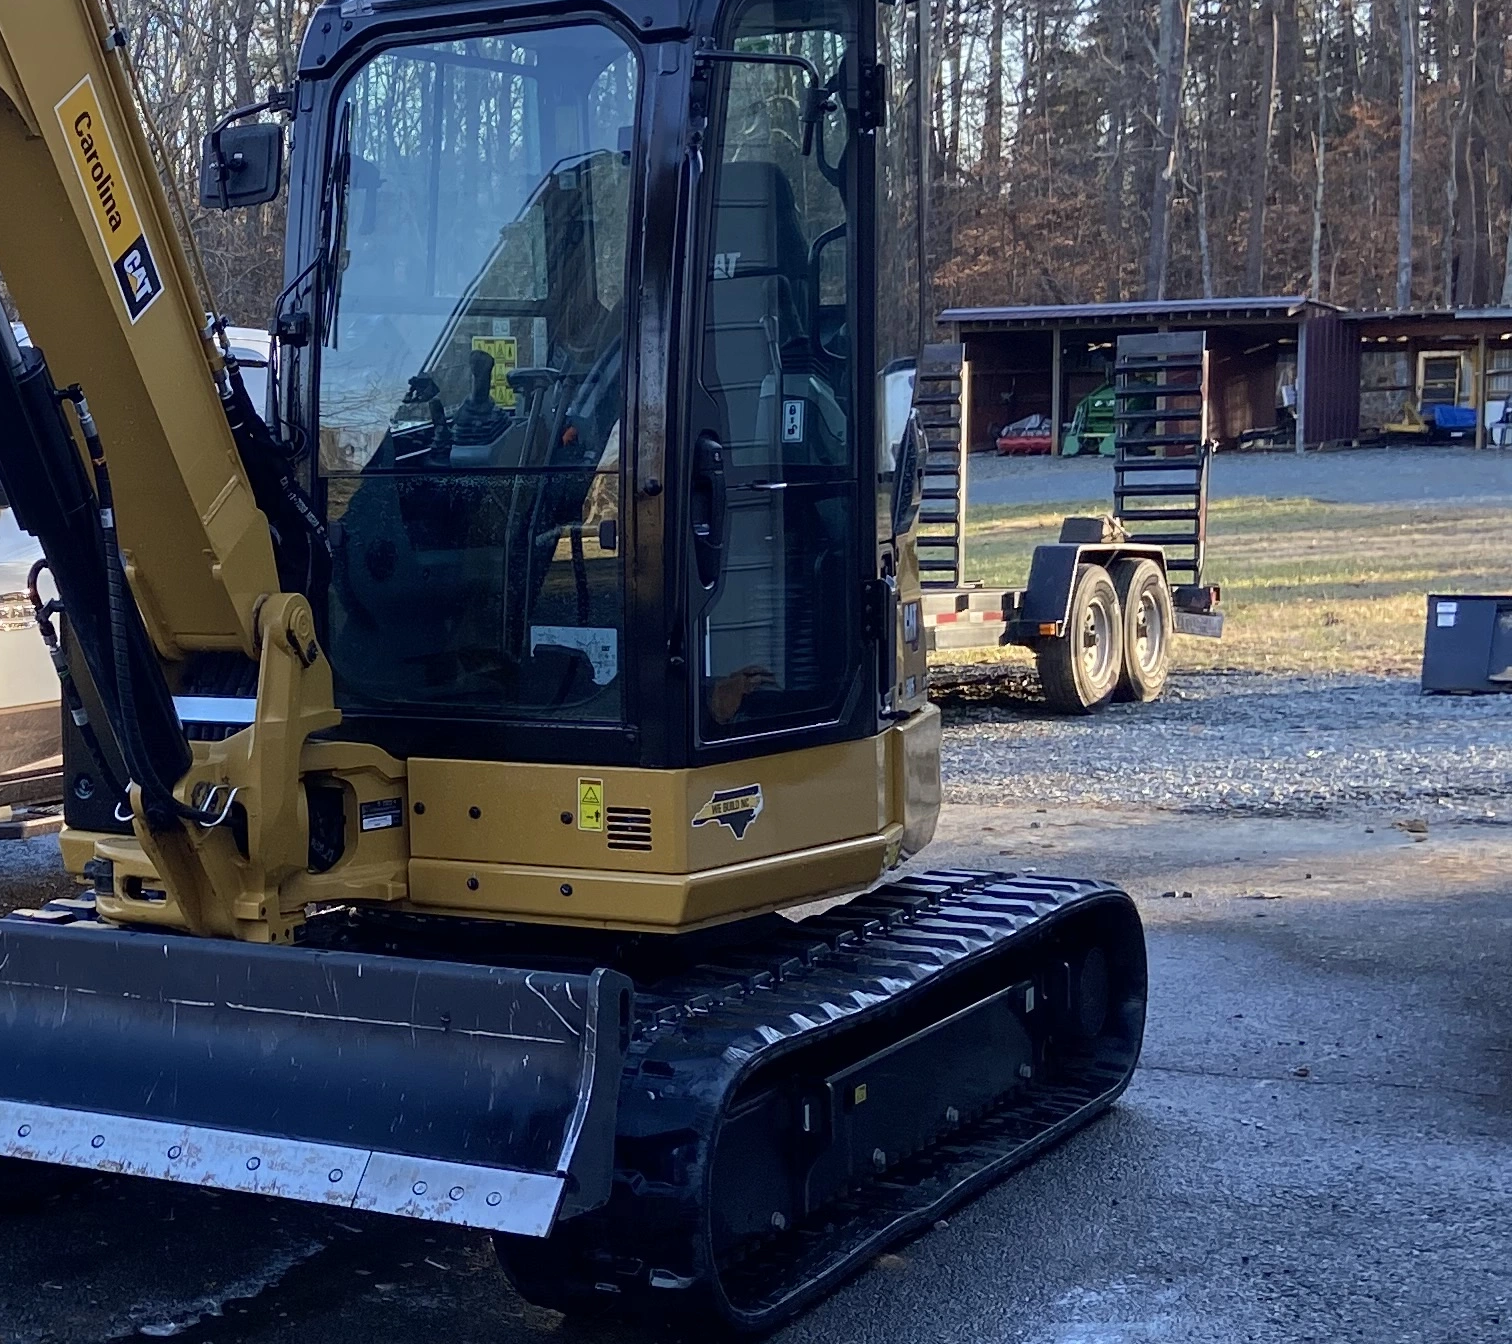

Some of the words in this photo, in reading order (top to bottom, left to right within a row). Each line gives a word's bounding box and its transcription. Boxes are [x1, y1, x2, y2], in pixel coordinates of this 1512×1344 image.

[74, 111, 123, 234] Carolina
[123, 249, 153, 304] CAT
[713, 251, 741, 279] AT
[722, 799, 740, 813] BUILD
